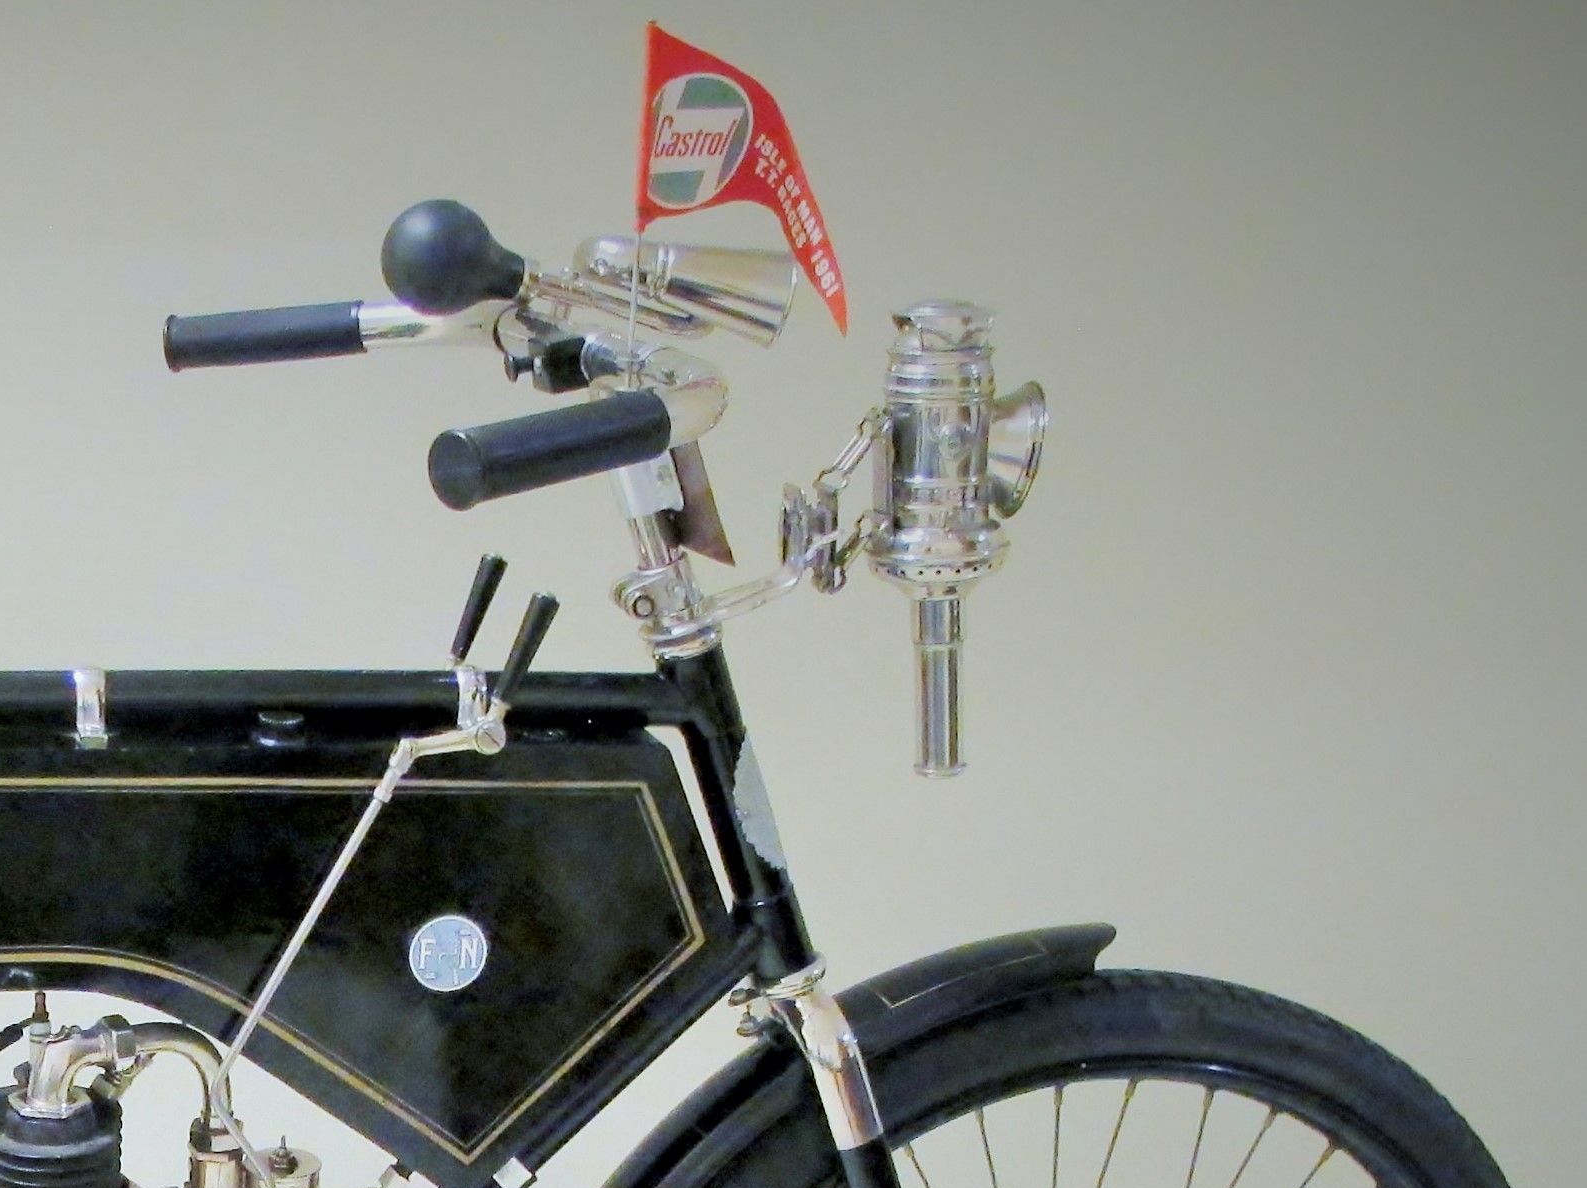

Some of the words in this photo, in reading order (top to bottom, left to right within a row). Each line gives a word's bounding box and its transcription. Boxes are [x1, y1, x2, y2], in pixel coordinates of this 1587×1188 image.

[654, 115, 737, 157] Castrol
[797, 199, 822, 246] MAN
[811, 249, 839, 297] 1961
